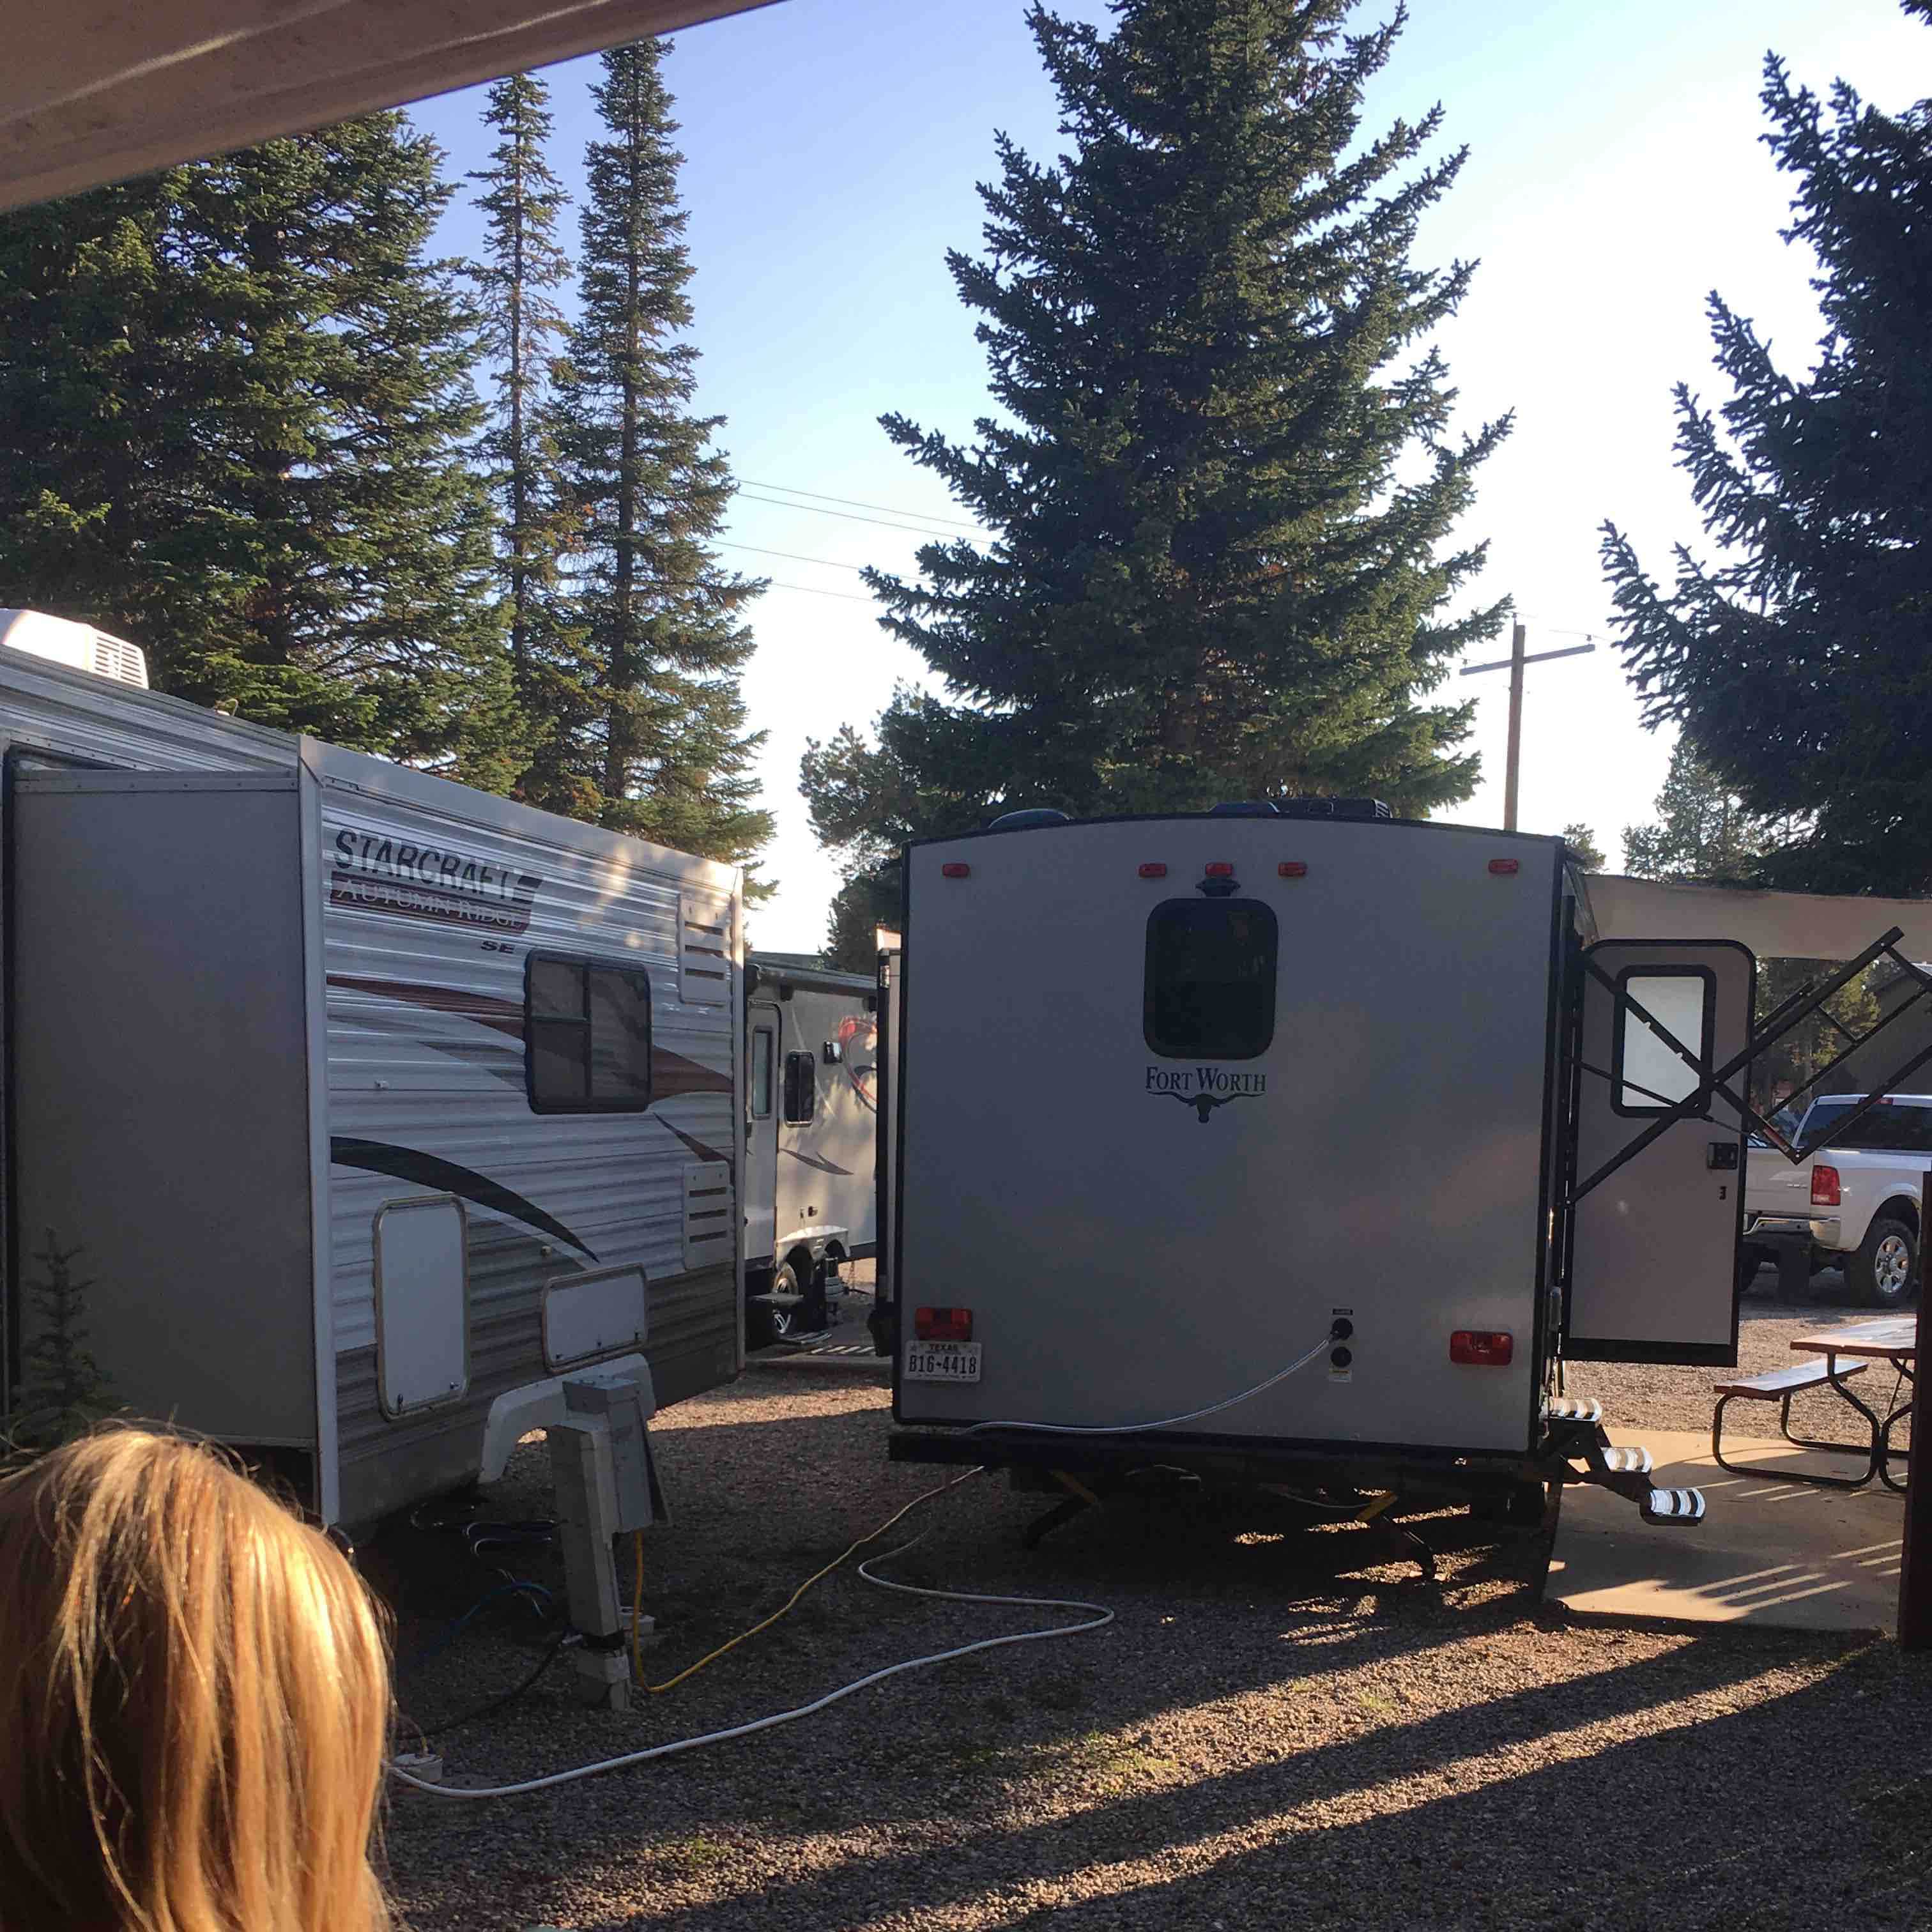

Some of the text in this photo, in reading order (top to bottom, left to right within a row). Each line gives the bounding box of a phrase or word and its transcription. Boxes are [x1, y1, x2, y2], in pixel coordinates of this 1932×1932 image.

[334, 829, 519, 899] STARCRAFT
[337, 878, 523, 930] AUTUMN RIDGE
[480, 940, 516, 954] SE
[1145, 1066, 1267, 1091] FORT WORTH
